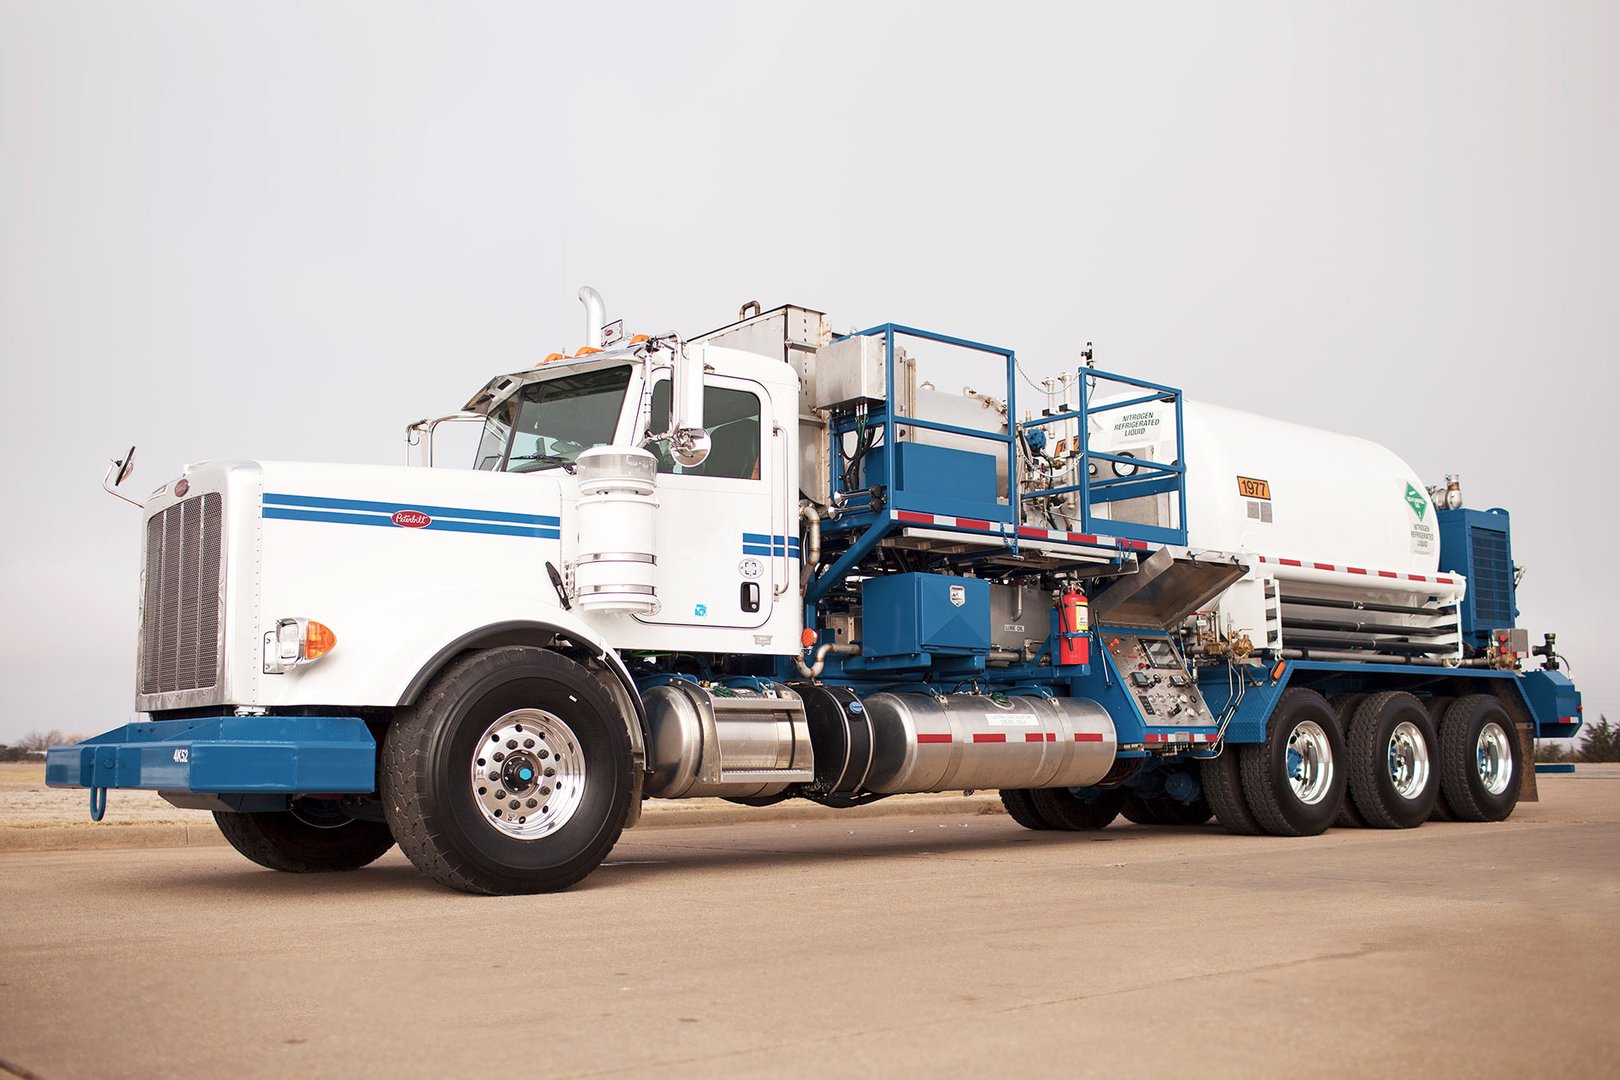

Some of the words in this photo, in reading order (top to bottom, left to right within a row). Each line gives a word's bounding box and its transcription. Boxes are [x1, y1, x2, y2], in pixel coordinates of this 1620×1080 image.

[1122, 412, 1154, 421] NITROGEN
[1113, 419, 1160, 431] REFRIGERATED
[1124, 428, 1146, 437] LIQUID
[1242, 480, 1266, 496] 1977
[395, 512, 428, 524] Peterbilt
[173, 749, 188, 762] 4K52
